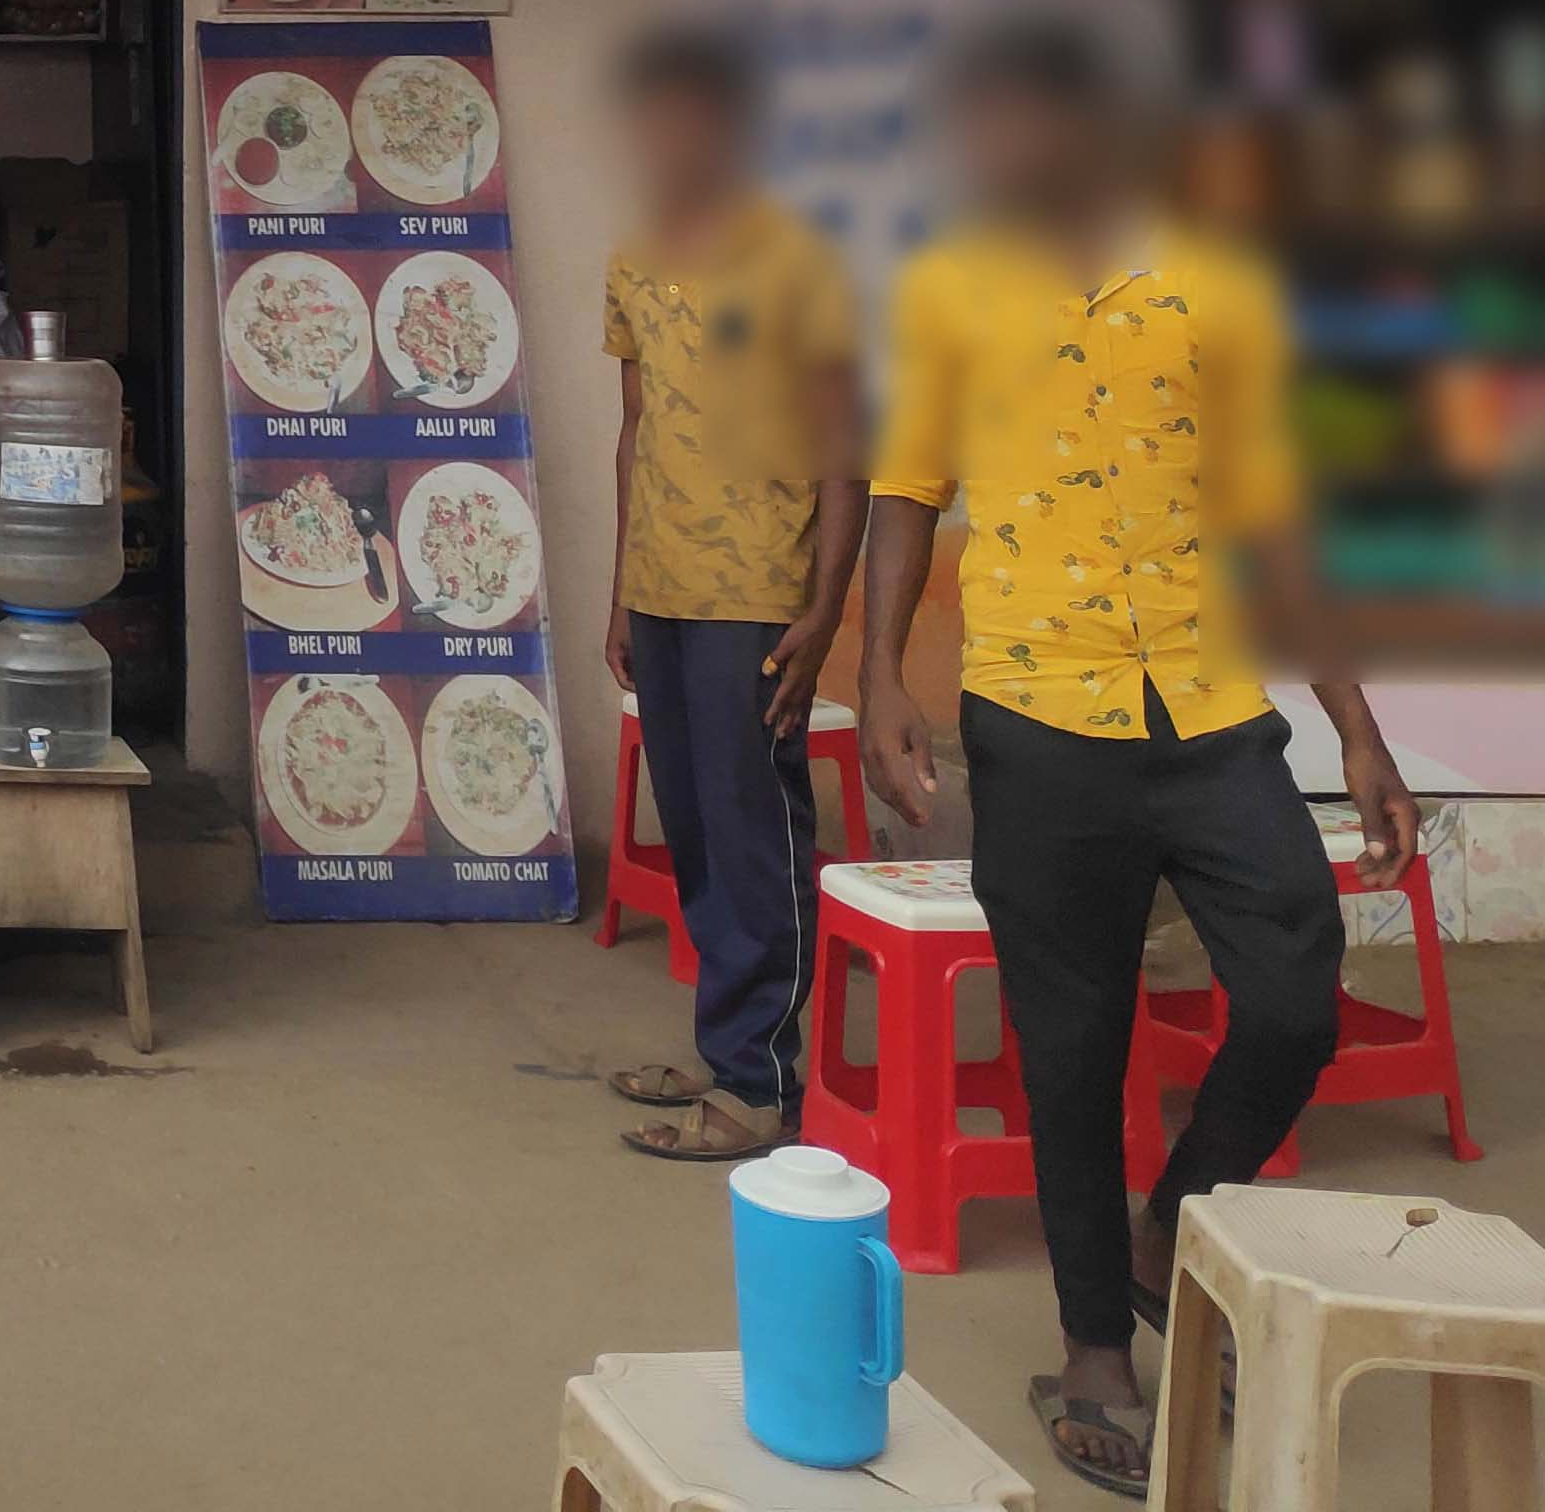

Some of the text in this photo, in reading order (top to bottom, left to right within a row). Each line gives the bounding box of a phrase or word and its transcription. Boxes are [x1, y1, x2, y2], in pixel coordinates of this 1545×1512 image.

[249, 217, 325, 235] PANI PURI
[400, 217, 468, 235] SEV PURI
[267, 418, 347, 437] DHAI PURI
[416, 418, 496, 437] AALU PURI
[288, 635, 362, 655] BHEL PURI
[444, 637, 513, 657] DRY PURI
[298, 860, 393, 880] MASALA PURI
[454, 862, 549, 881] TOMATO CHAT
